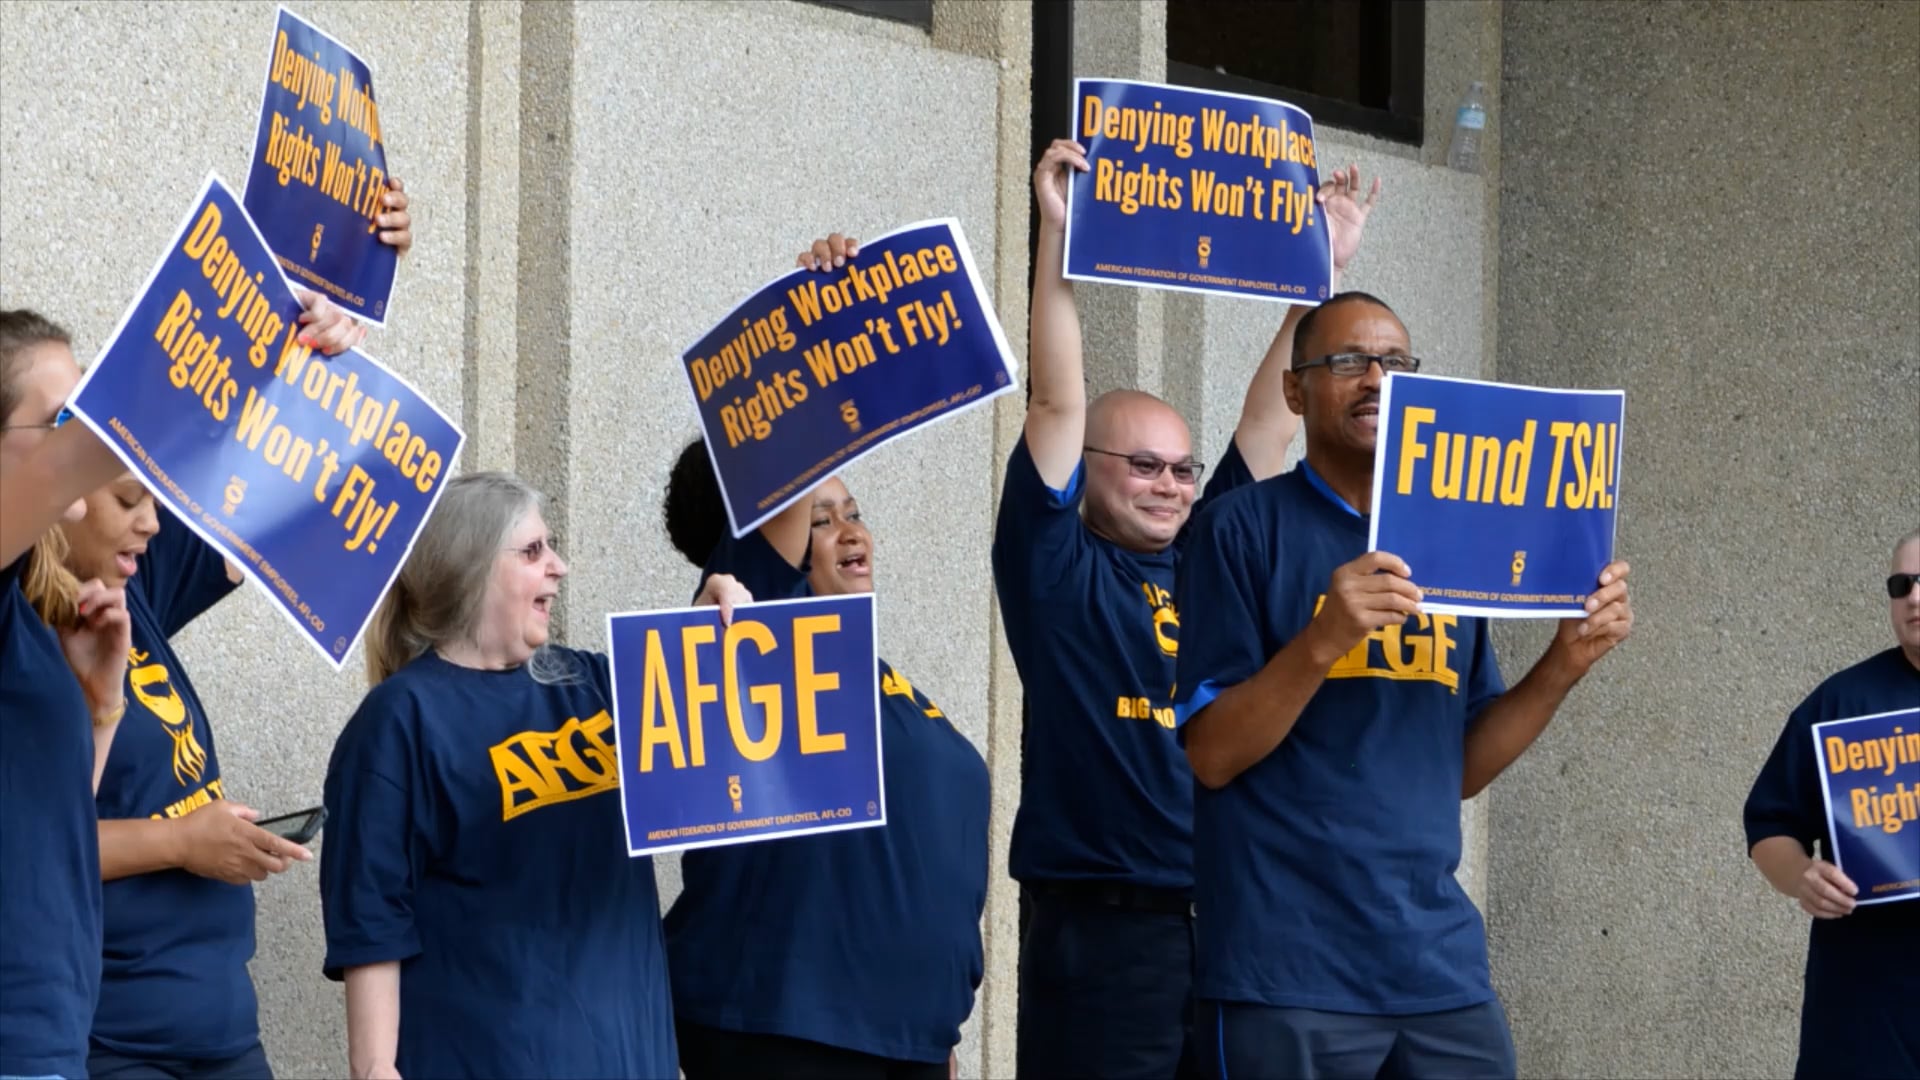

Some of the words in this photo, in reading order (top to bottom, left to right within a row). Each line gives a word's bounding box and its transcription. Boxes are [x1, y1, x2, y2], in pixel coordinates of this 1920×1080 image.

[271, 29, 336, 125] Denying
[265, 111, 320, 186] Rights
[320, 140, 366, 213] Won't
[1083, 95, 1195, 158] Denying
[1202, 107, 1316, 169] Workplace
[1095, 158, 1183, 215] Rights
[1191, 168, 1265, 220] Won't
[1271, 179, 1314, 235] Fly!
[182, 201, 283, 369] Denying
[274, 322, 443, 493] Workplace
[690, 305, 797, 401] Denying
[787, 244, 957, 328] Workplace
[719, 368, 809, 448] Rights
[803, 316, 901, 389] Won't
[896, 290, 963, 346] Fly!
[154, 289, 238, 421] Rights
[235, 386, 340, 503] Won't
[330, 464, 400, 555] Fly!
[1397, 406, 1537, 507] Fund
[1545, 421, 1617, 510] TSA!
[639, 614, 847, 773] AFGE
[1116, 696, 1150, 719] BIG
[1825, 726, 1920, 776] Denyin
[1851, 782, 1920, 834] Righ
